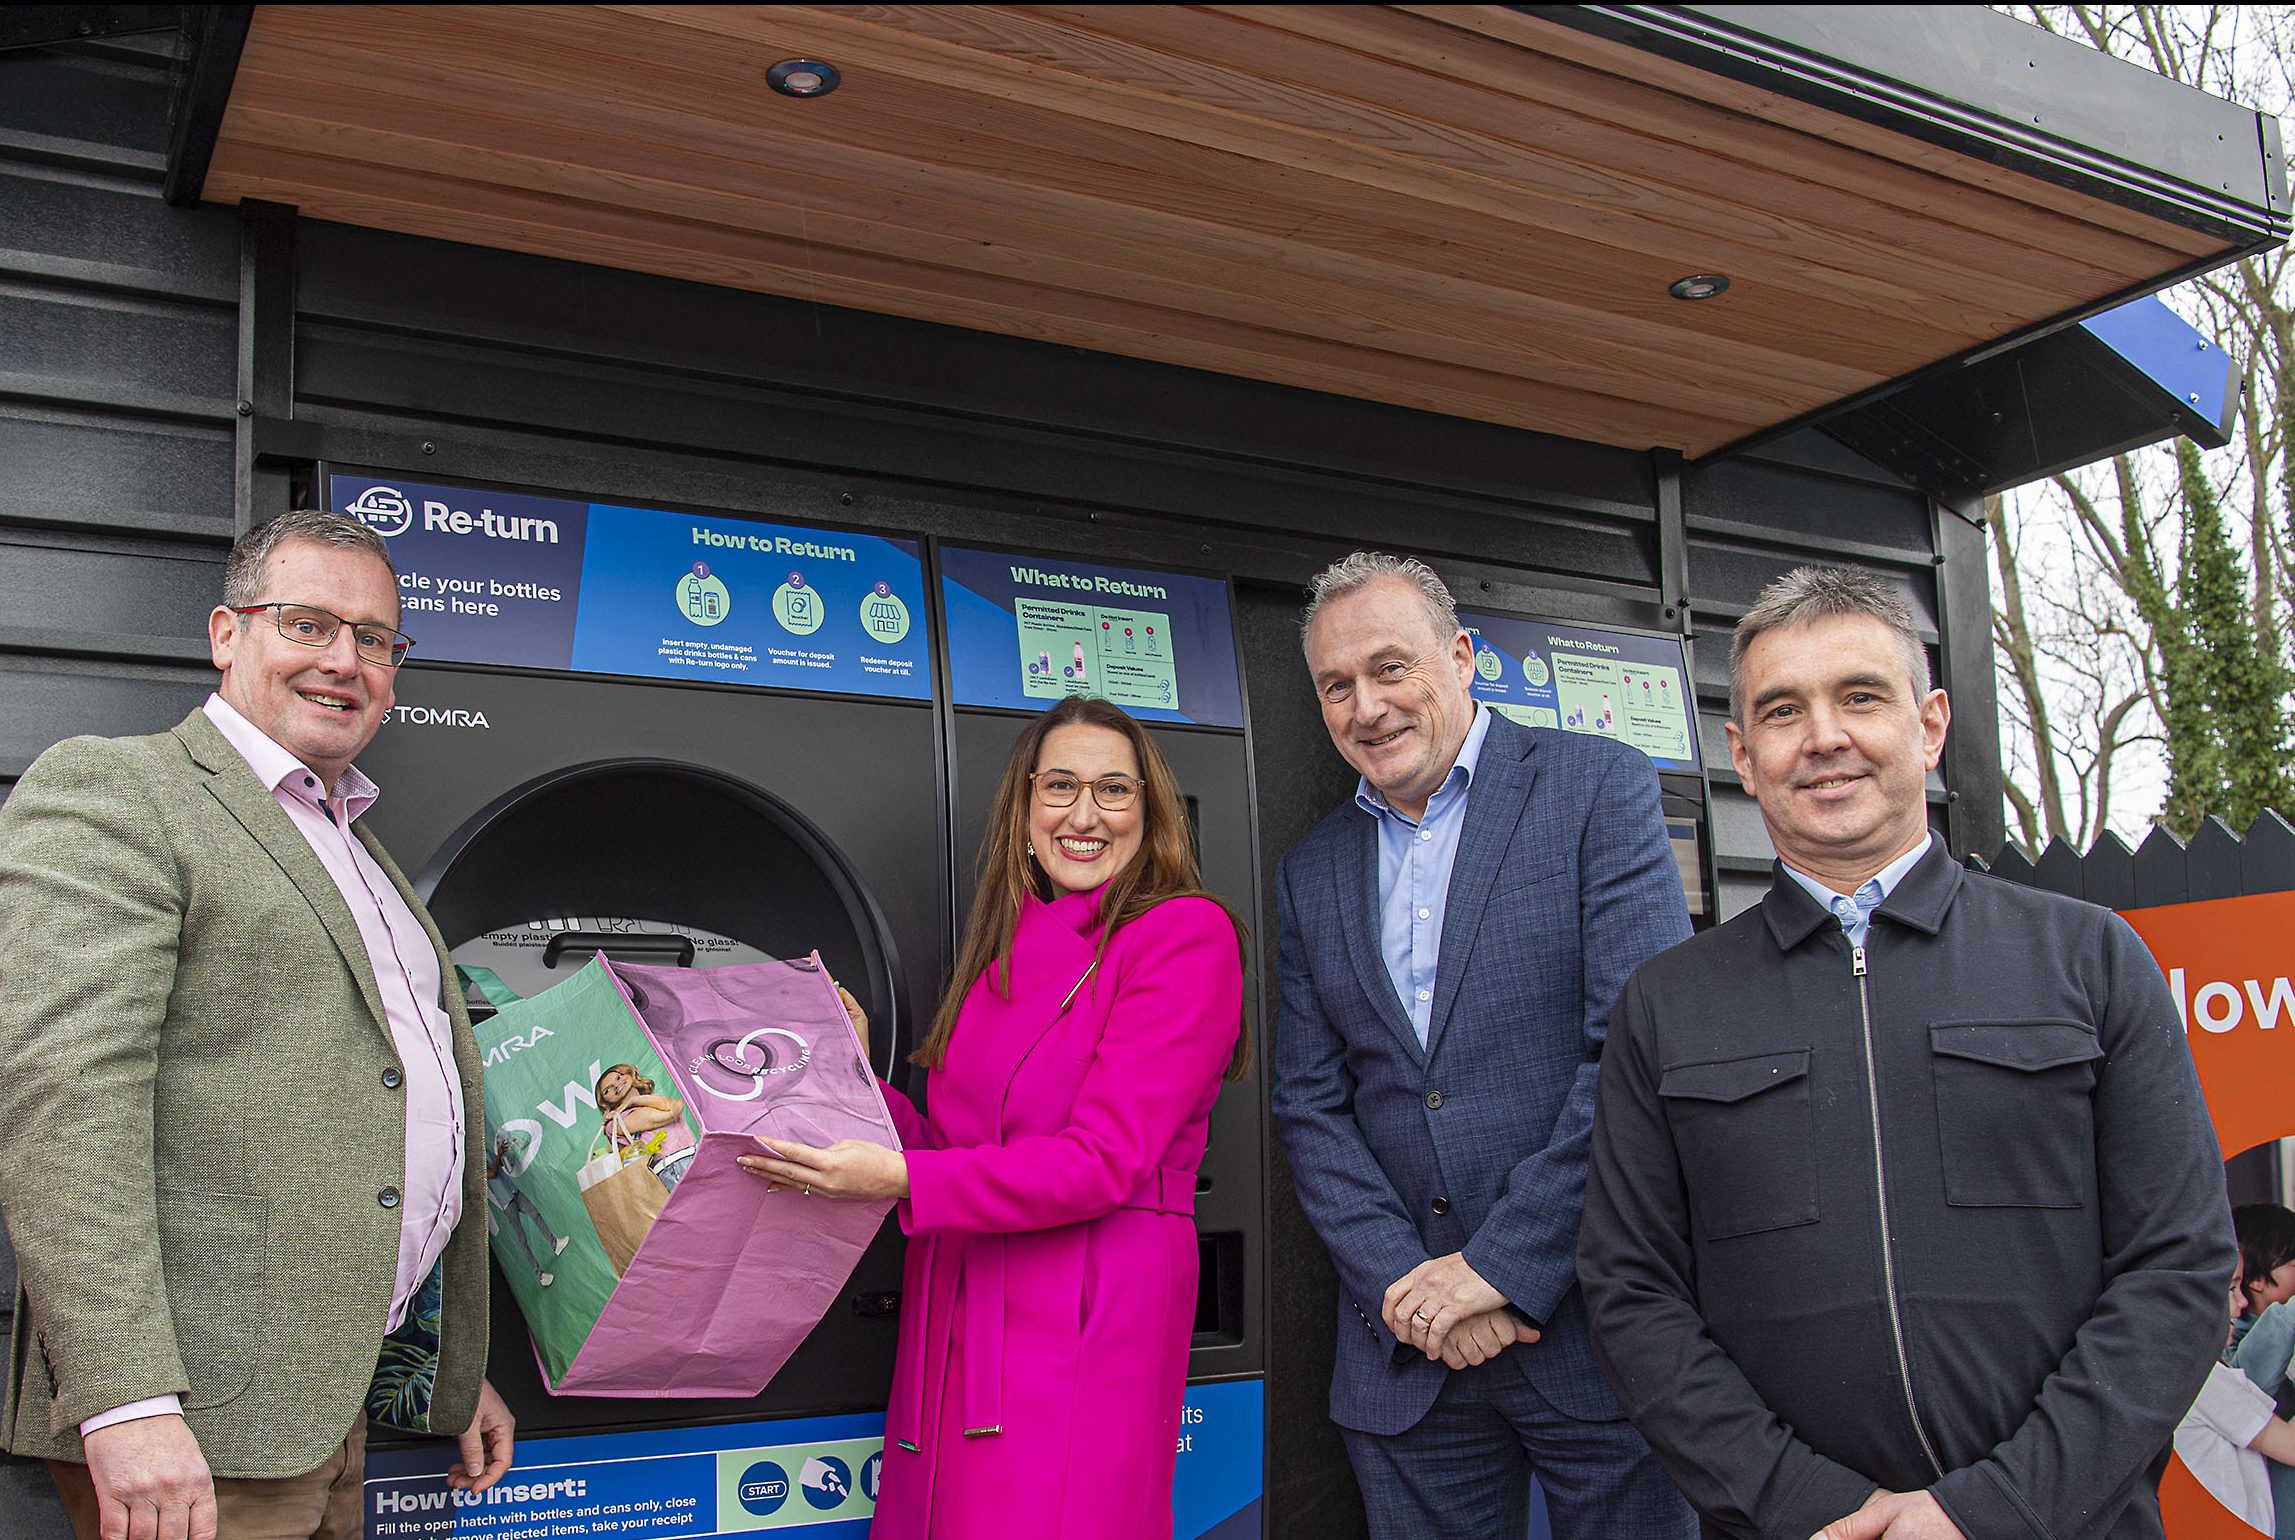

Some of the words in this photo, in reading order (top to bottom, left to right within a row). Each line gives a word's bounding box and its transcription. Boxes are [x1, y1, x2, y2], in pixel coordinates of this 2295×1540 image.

[424, 500, 559, 544] Re-turn
[692, 527, 745, 550] How
[749, 534, 773, 553] to
[775, 536, 856, 562] Return
[697, 565, 704, 576] 1
[792, 574, 800, 585] 2
[1010, 566, 1069, 589] What
[1071, 575, 1093, 592] to
[1094, 576, 1167, 600] Return
[436, 577, 485, 595] your
[490, 579, 561, 601] bottles
[879, 584, 886, 595] 3
[451, 597, 499, 616] here
[1021, 604, 1060, 614] Permitted
[1060, 607, 1086, 617] Drinks
[1023, 611, 1065, 622] Containers
[662, 637, 684, 647] Insert
[685, 641, 710, 650] empty,
[710, 643, 753, 654] undamaged
[1547, 636, 1575, 648] What
[1574, 640, 1586, 649] to
[1585, 641, 1619, 654] Return
[658, 647, 683, 656] plastic
[684, 649, 706, 658] drinks
[707, 651, 733, 660] bottles
[740, 655, 757, 663] cans
[767, 647, 797, 657] Voucher
[798, 650, 808, 658] for
[808, 651, 835, 661] deposit
[668, 657, 685, 665] with
[685, 658, 713, 668] Re-turn
[714, 660, 731, 670] logo
[731, 662, 749, 671] only.
[772, 658, 799, 666] amount
[800, 659, 806, 667] is
[806, 659, 832, 669] issued.
[860, 656, 888, 666] Redeem
[888, 658, 913, 669] deposit
[864, 666, 893, 675] voucher
[394, 705, 490, 729] TOMRA
[481, 933, 518, 942] Empty
[522, 933, 554, 942] plasti
[707, 938, 739, 947] glass!
[688, 1053, 716, 1074] CLEAN
[718, 1054, 750, 1070] LOOP
[751, 1048, 811, 1075] RECYCLING
[376, 1491, 447, 1514] How
[451, 1488, 483, 1507] to
[487, 1478, 586, 1505] Insert:
[749, 1484, 780, 1496] START
[376, 1523, 396, 1535] Fill
[399, 1522, 421, 1533] the
[424, 1519, 457, 1532] open
[460, 1513, 497, 1528] hatch
[499, 1511, 527, 1524] with
[530, 1508, 573, 1522] bottles
[576, 1504, 600, 1517] and
[603, 1503, 632, 1515] cans
[634, 1499, 663, 1512] only,
[665, 1497, 697, 1509] close
[497, 1526, 548, 1540] rejected
[551, 1523, 589, 1537] items,
[592, 1520, 619, 1532] take
[621, 1517, 649, 1532] your
[651, 1512, 693, 1527] receipt
